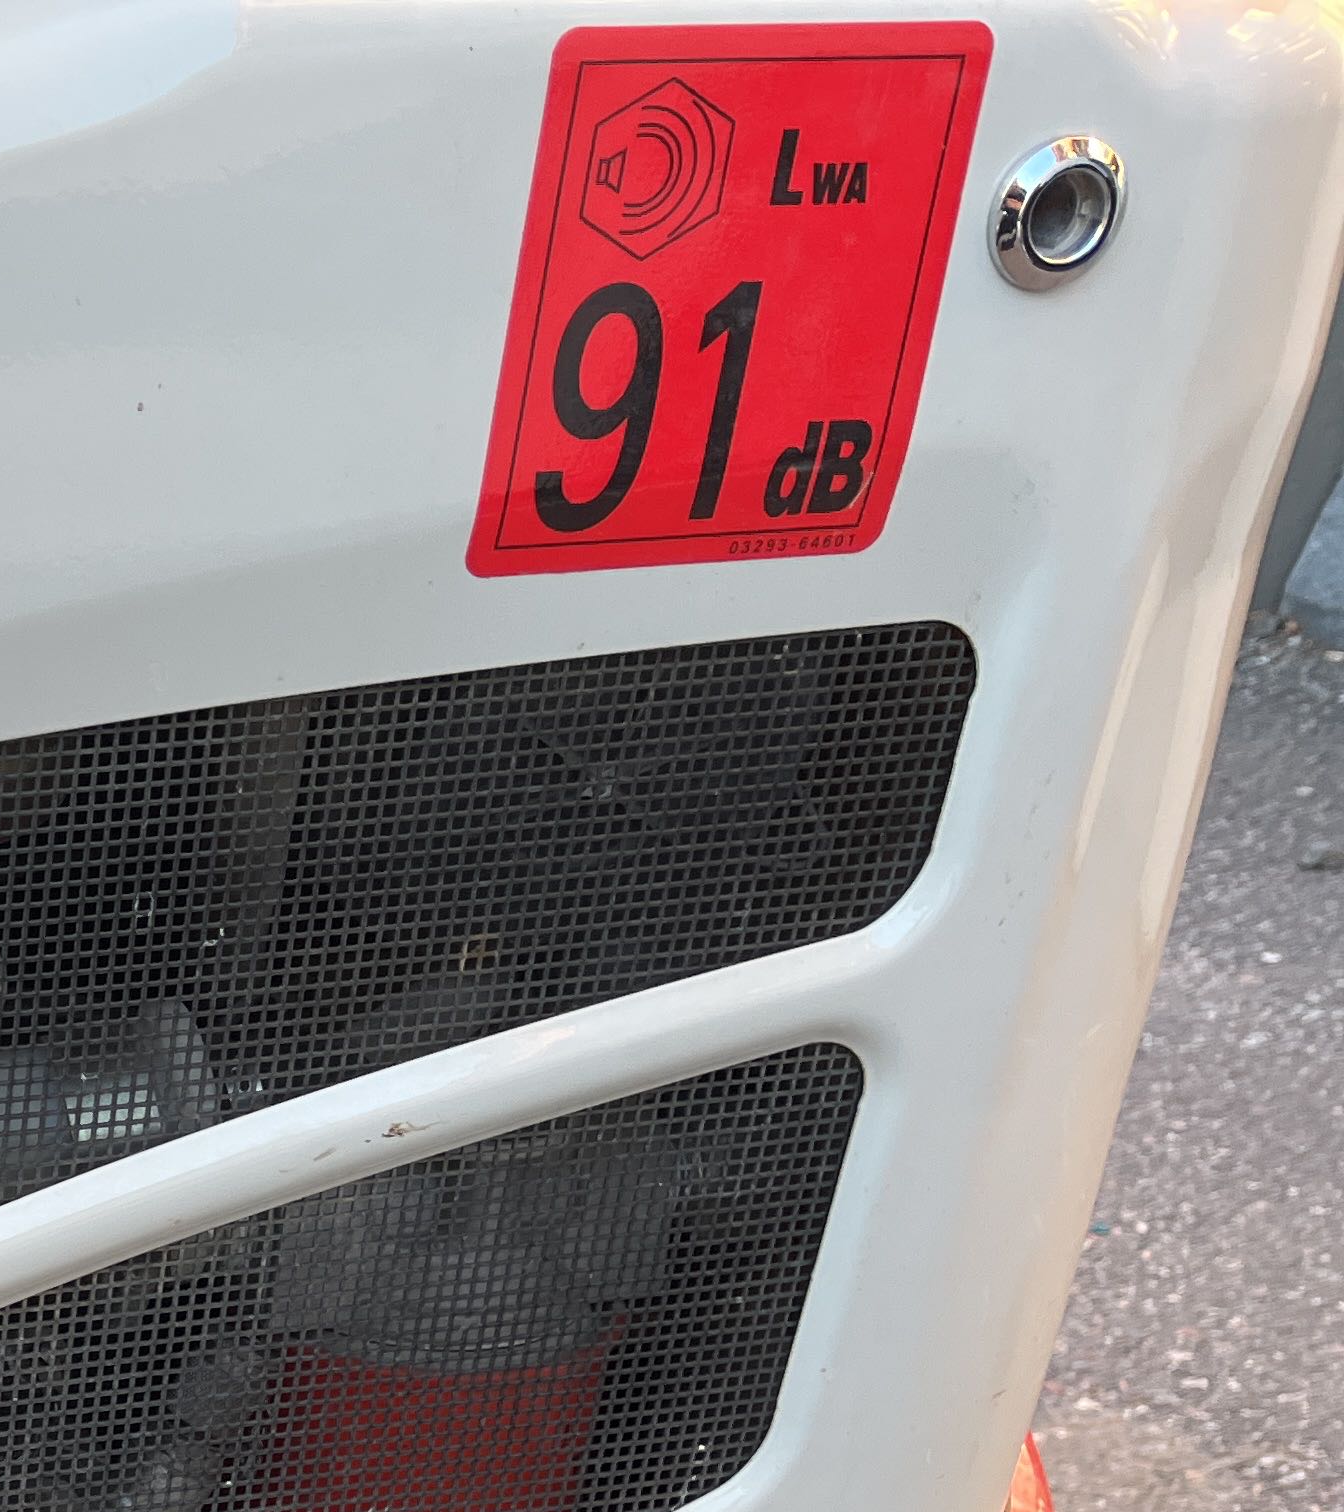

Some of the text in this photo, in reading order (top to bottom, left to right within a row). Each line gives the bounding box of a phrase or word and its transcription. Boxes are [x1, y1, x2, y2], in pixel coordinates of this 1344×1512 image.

[534, 281, 873, 532] 91 dB
[728, 533, 857, 555] 03293-64601
